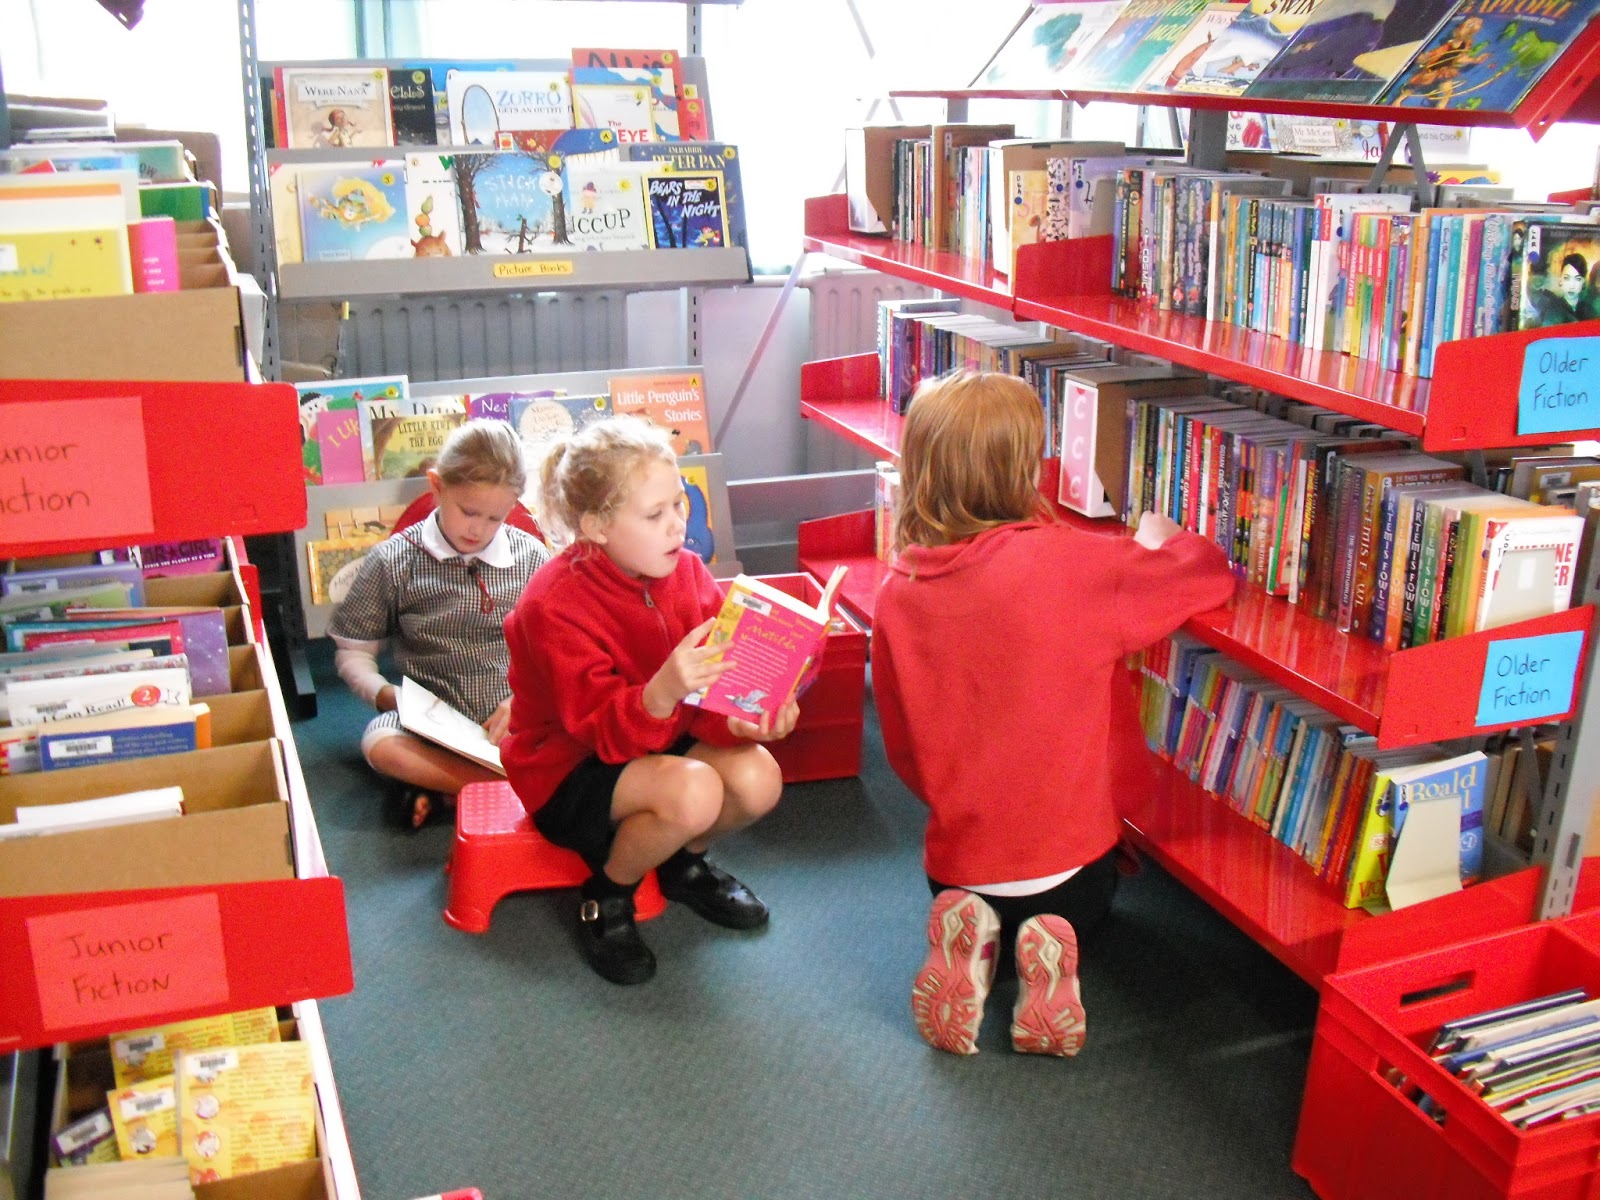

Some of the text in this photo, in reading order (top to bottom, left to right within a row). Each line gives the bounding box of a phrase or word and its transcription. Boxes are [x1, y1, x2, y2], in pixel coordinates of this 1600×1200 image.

[497, 89, 562, 106] ZORRO
[618, 129, 648, 142] EYE
[699, 155, 726, 168] PAN
[649, 180, 682, 196] BEARS
[666, 190, 702, 207] IN THE
[681, 201, 721, 218] NIGHT
[498, 263, 569, 276] Picture Books
[1141, 249, 1150, 289] COSMIC
[1350, 252, 1358, 280] FAMOUS
[1538, 351, 1588, 374] Older
[617, 387, 700, 406] Little Penguin's
[1074, 395, 1086, 419] C
[1533, 385, 1588, 411] Fiction
[398, 420, 427, 434] LITTLE
[664, 408, 703, 422] Stories
[409, 436, 444, 448] THE EGG
[1071, 436, 1085, 460] C
[1069, 475, 1081, 498] C
[1354, 484, 1376, 607] ARTEMIS FWL
[1378, 493, 1396, 600] ARTEMIS FOWL
[1405, 503, 1423, 612] ARTEMIS FOWL
[1420, 506, 1438, 617] ARTEMIS FOWL
[1496, 653, 1551, 678] Older
[142, 689, 151, 701] 2
[1493, 686, 1550, 710] Fiction
[51, 710, 82, 723] Can
[86, 698, 126, 715] Read!
[1408, 765, 1477, 801] Roald
[64, 930, 173, 961] Junior
[72, 971, 172, 1006] Fiction
